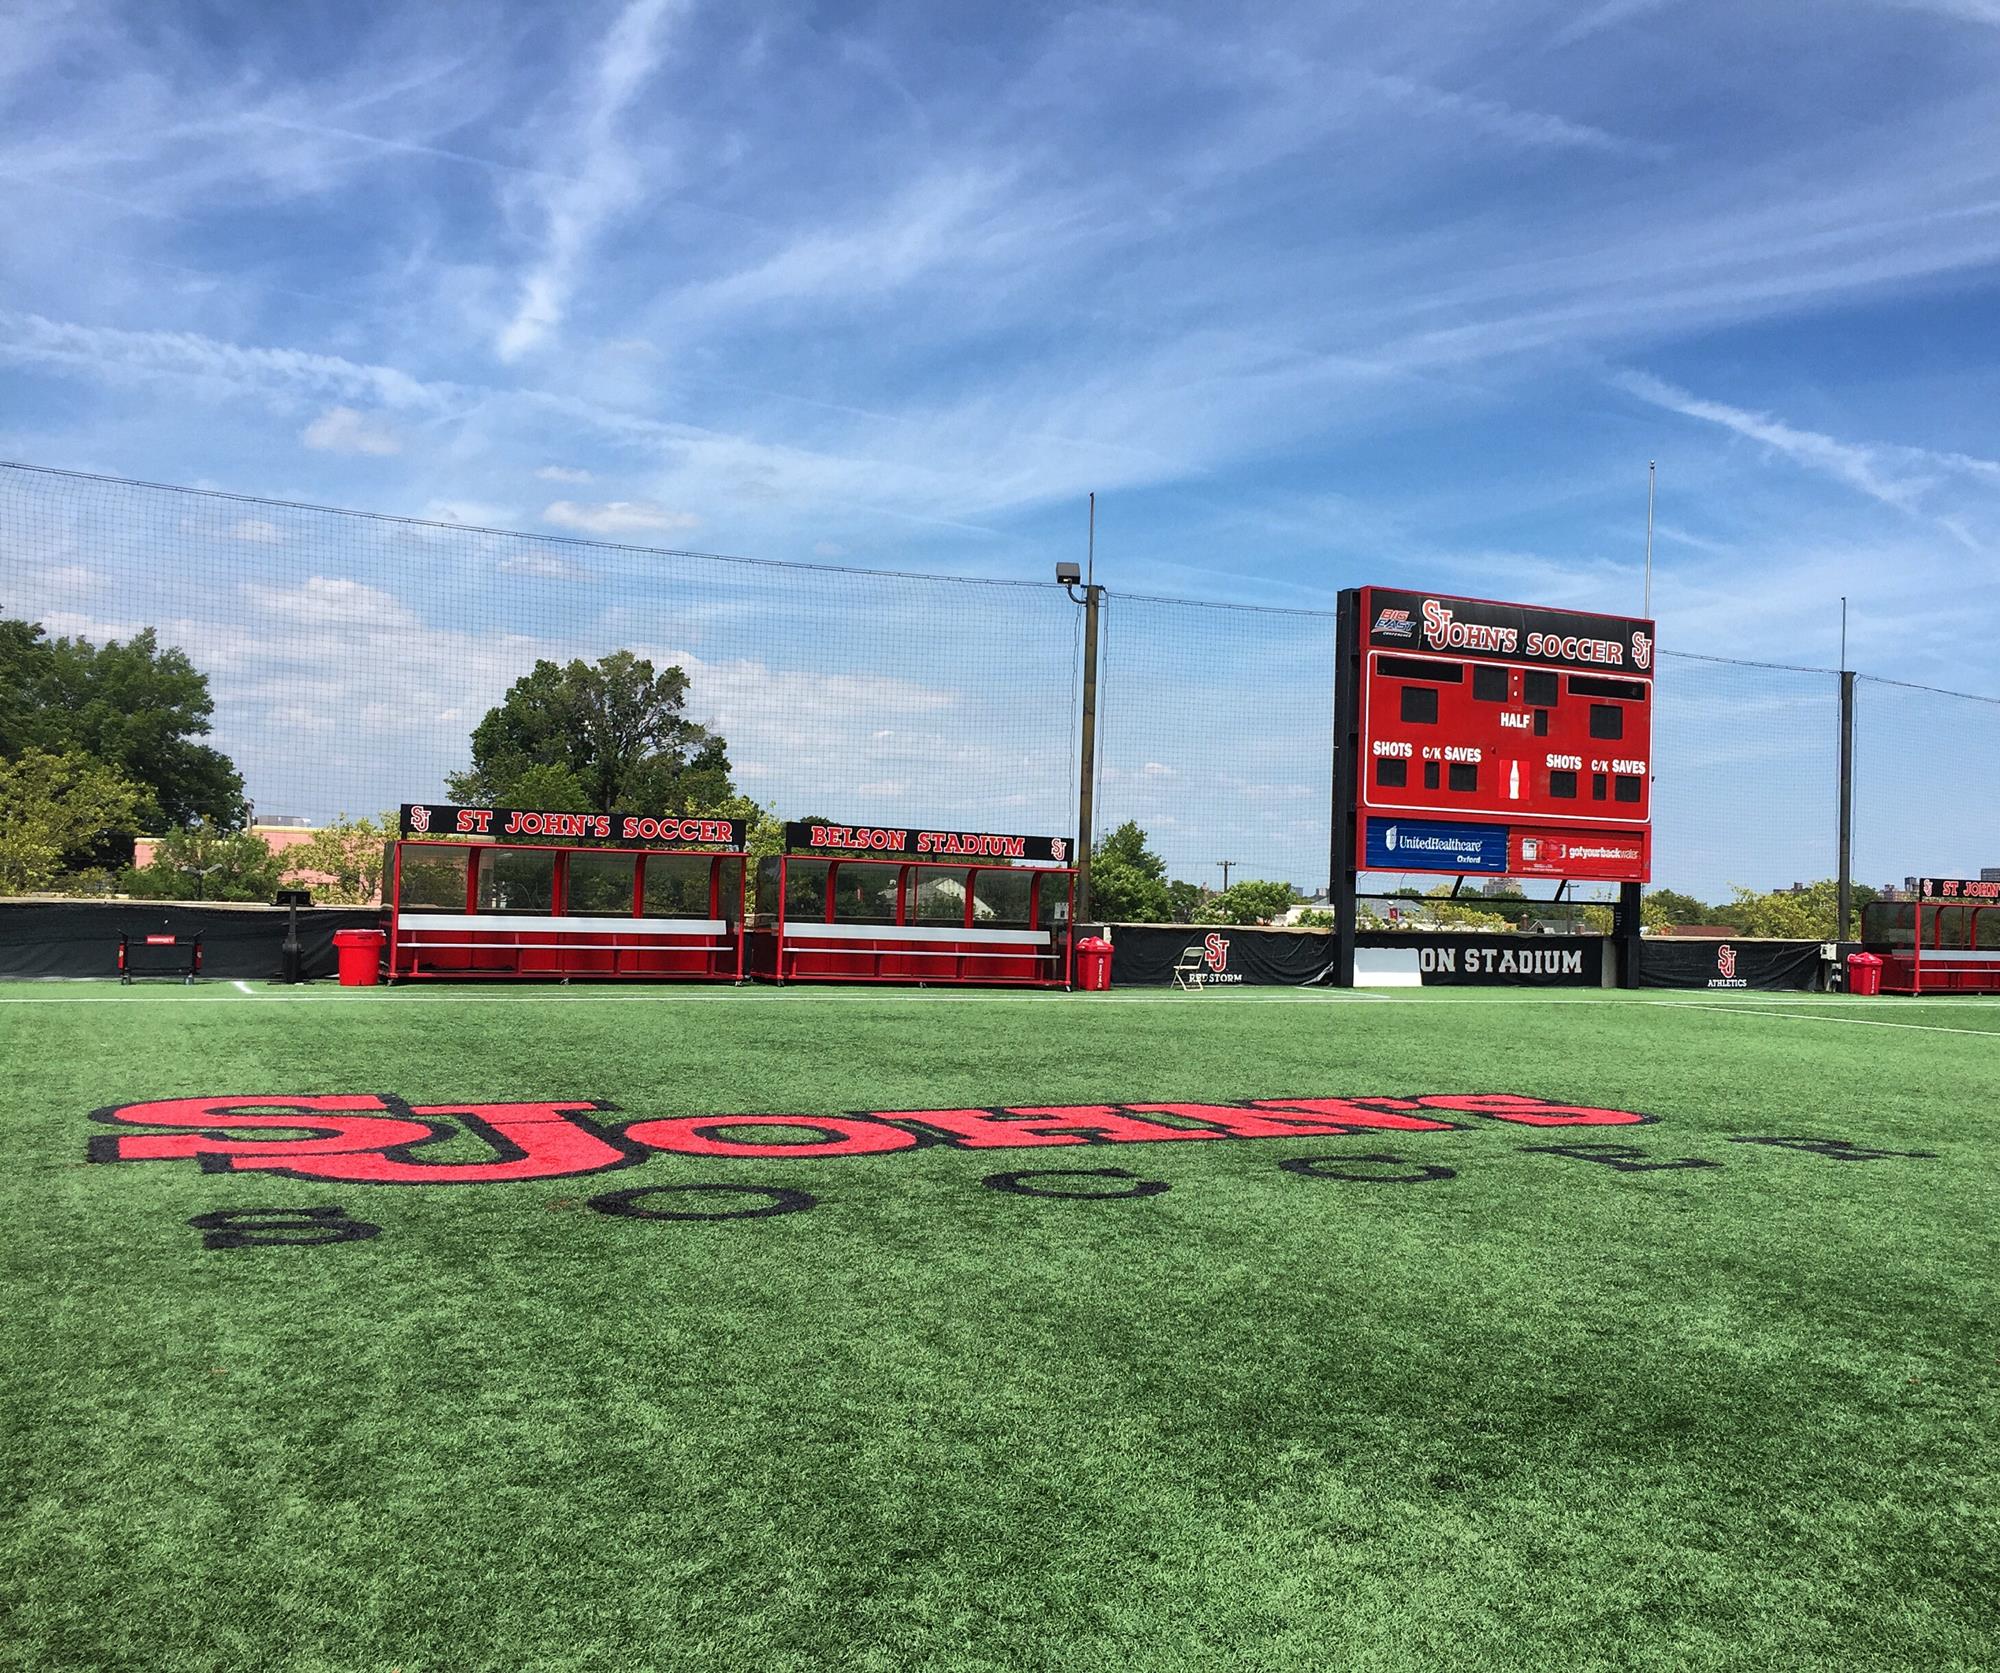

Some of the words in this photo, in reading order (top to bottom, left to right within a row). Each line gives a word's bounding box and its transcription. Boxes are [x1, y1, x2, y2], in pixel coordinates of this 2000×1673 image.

[1380, 608, 1410, 621] BIG
[1375, 617, 1416, 632] EAST
[1526, 632, 1623, 665] SOCCER
[1500, 712, 1530, 729] HALF
[1373, 740, 1413, 757] SHOTS
[1422, 746, 1441, 760] C/K
[1444, 745, 1482, 763] SAVES
[1546, 753, 1582, 770] SHOTS
[1591, 759, 1609, 773] C/K
[1612, 758, 1646, 775] SAVES
[456, 809, 493, 832] ST
[505, 812, 610, 837] JOHN'S
[623, 816, 733, 842] SOCCER
[811, 826, 907, 850] BELSON
[917, 832, 1025, 857] STADIUM
[1457, 855, 1481, 864] Oxford
[1942, 881, 1959, 896] ST
[1465, 949, 1582, 974] STADIUM
[1189, 973, 1208, 983] RED
[1209, 973, 1242, 983] STORM
[1707, 979, 1747, 987] ATHLETICS
[187, 1136, 1940, 1249] SOCCER
